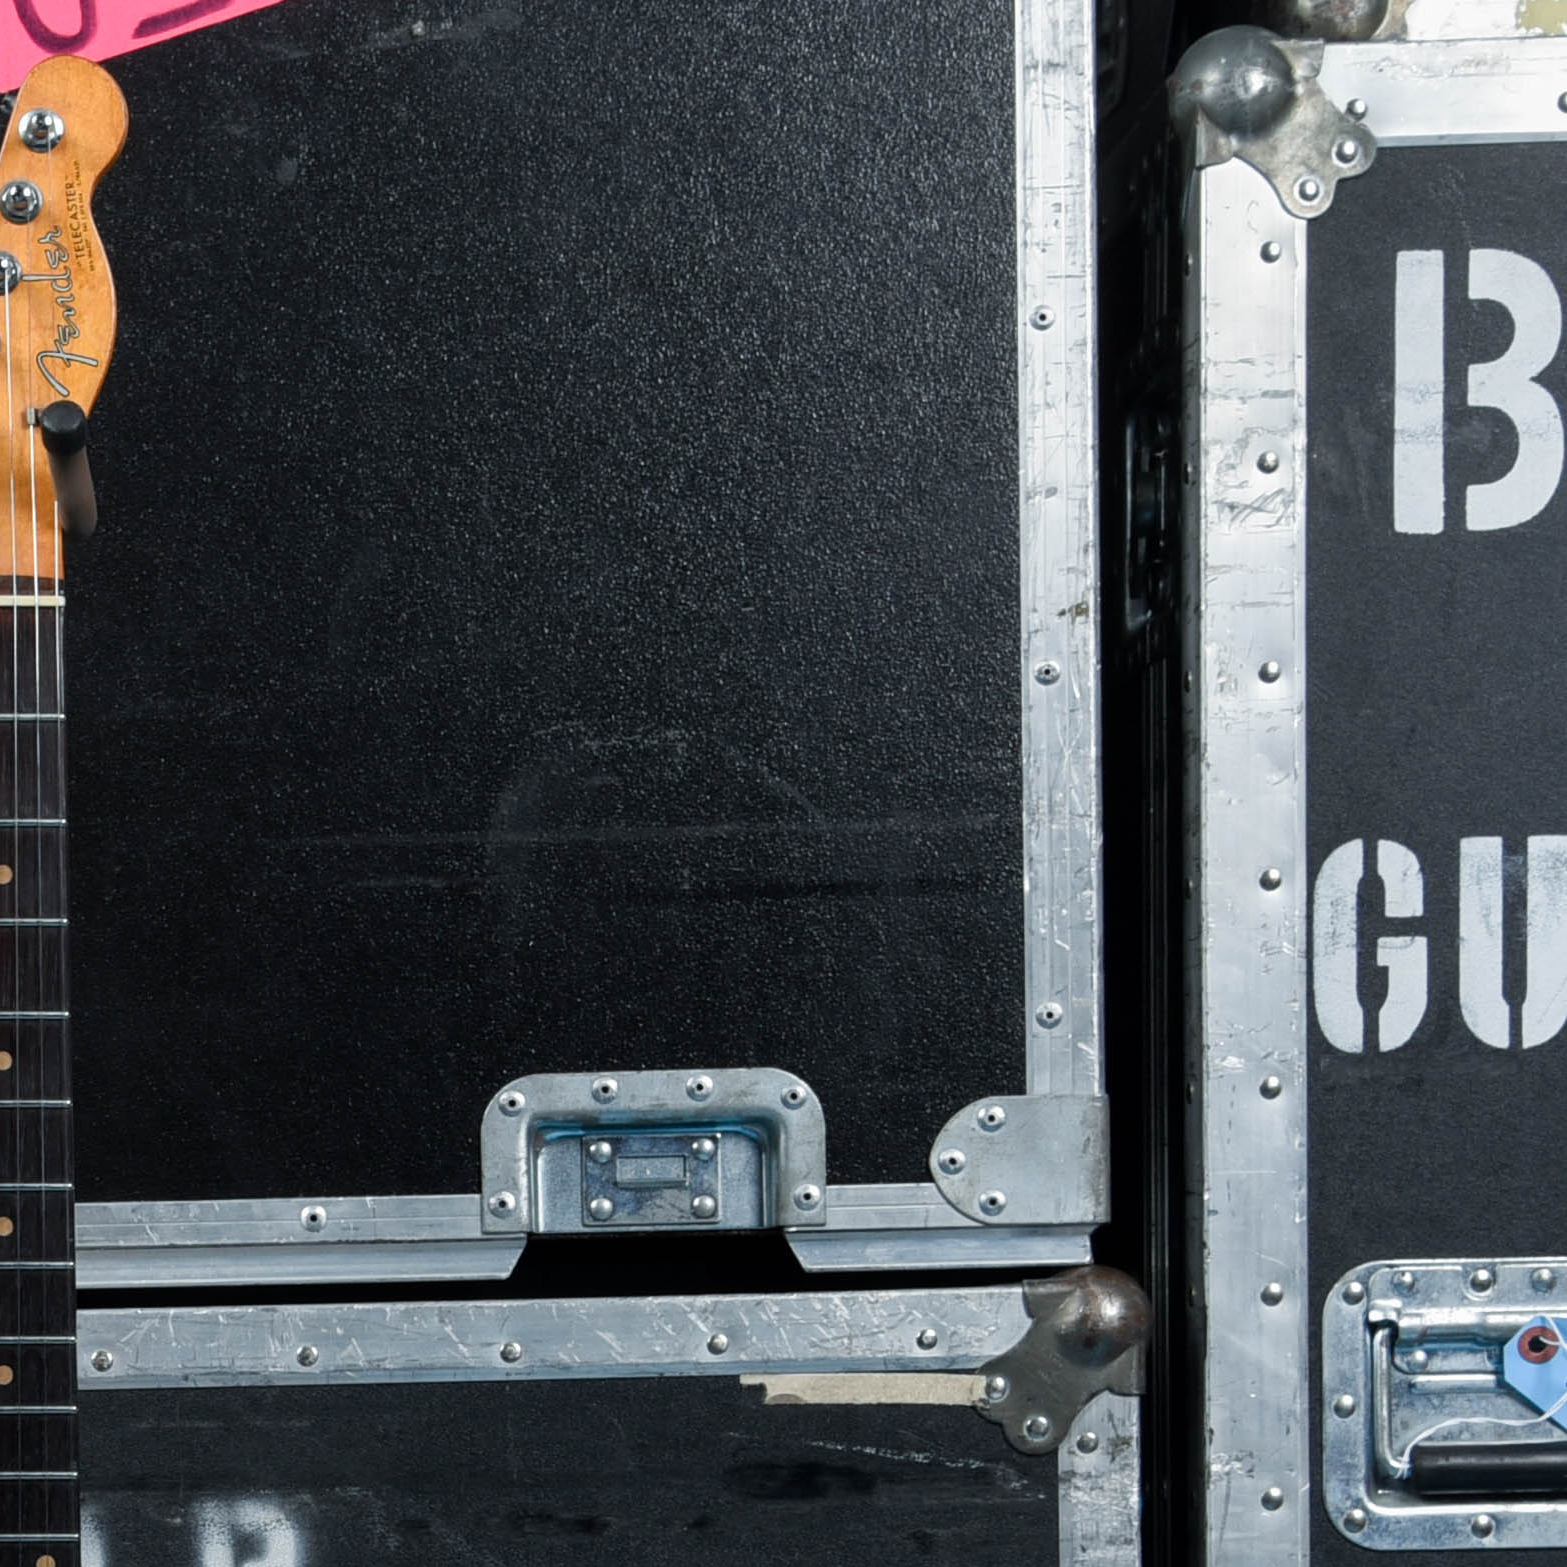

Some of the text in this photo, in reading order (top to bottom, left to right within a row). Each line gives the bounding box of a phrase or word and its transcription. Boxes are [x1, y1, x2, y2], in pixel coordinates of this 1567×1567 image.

[21, 224, 99, 396] Fender
[1393, 248, 1565, 534] B
[1312, 834, 1567, 1054] GU
